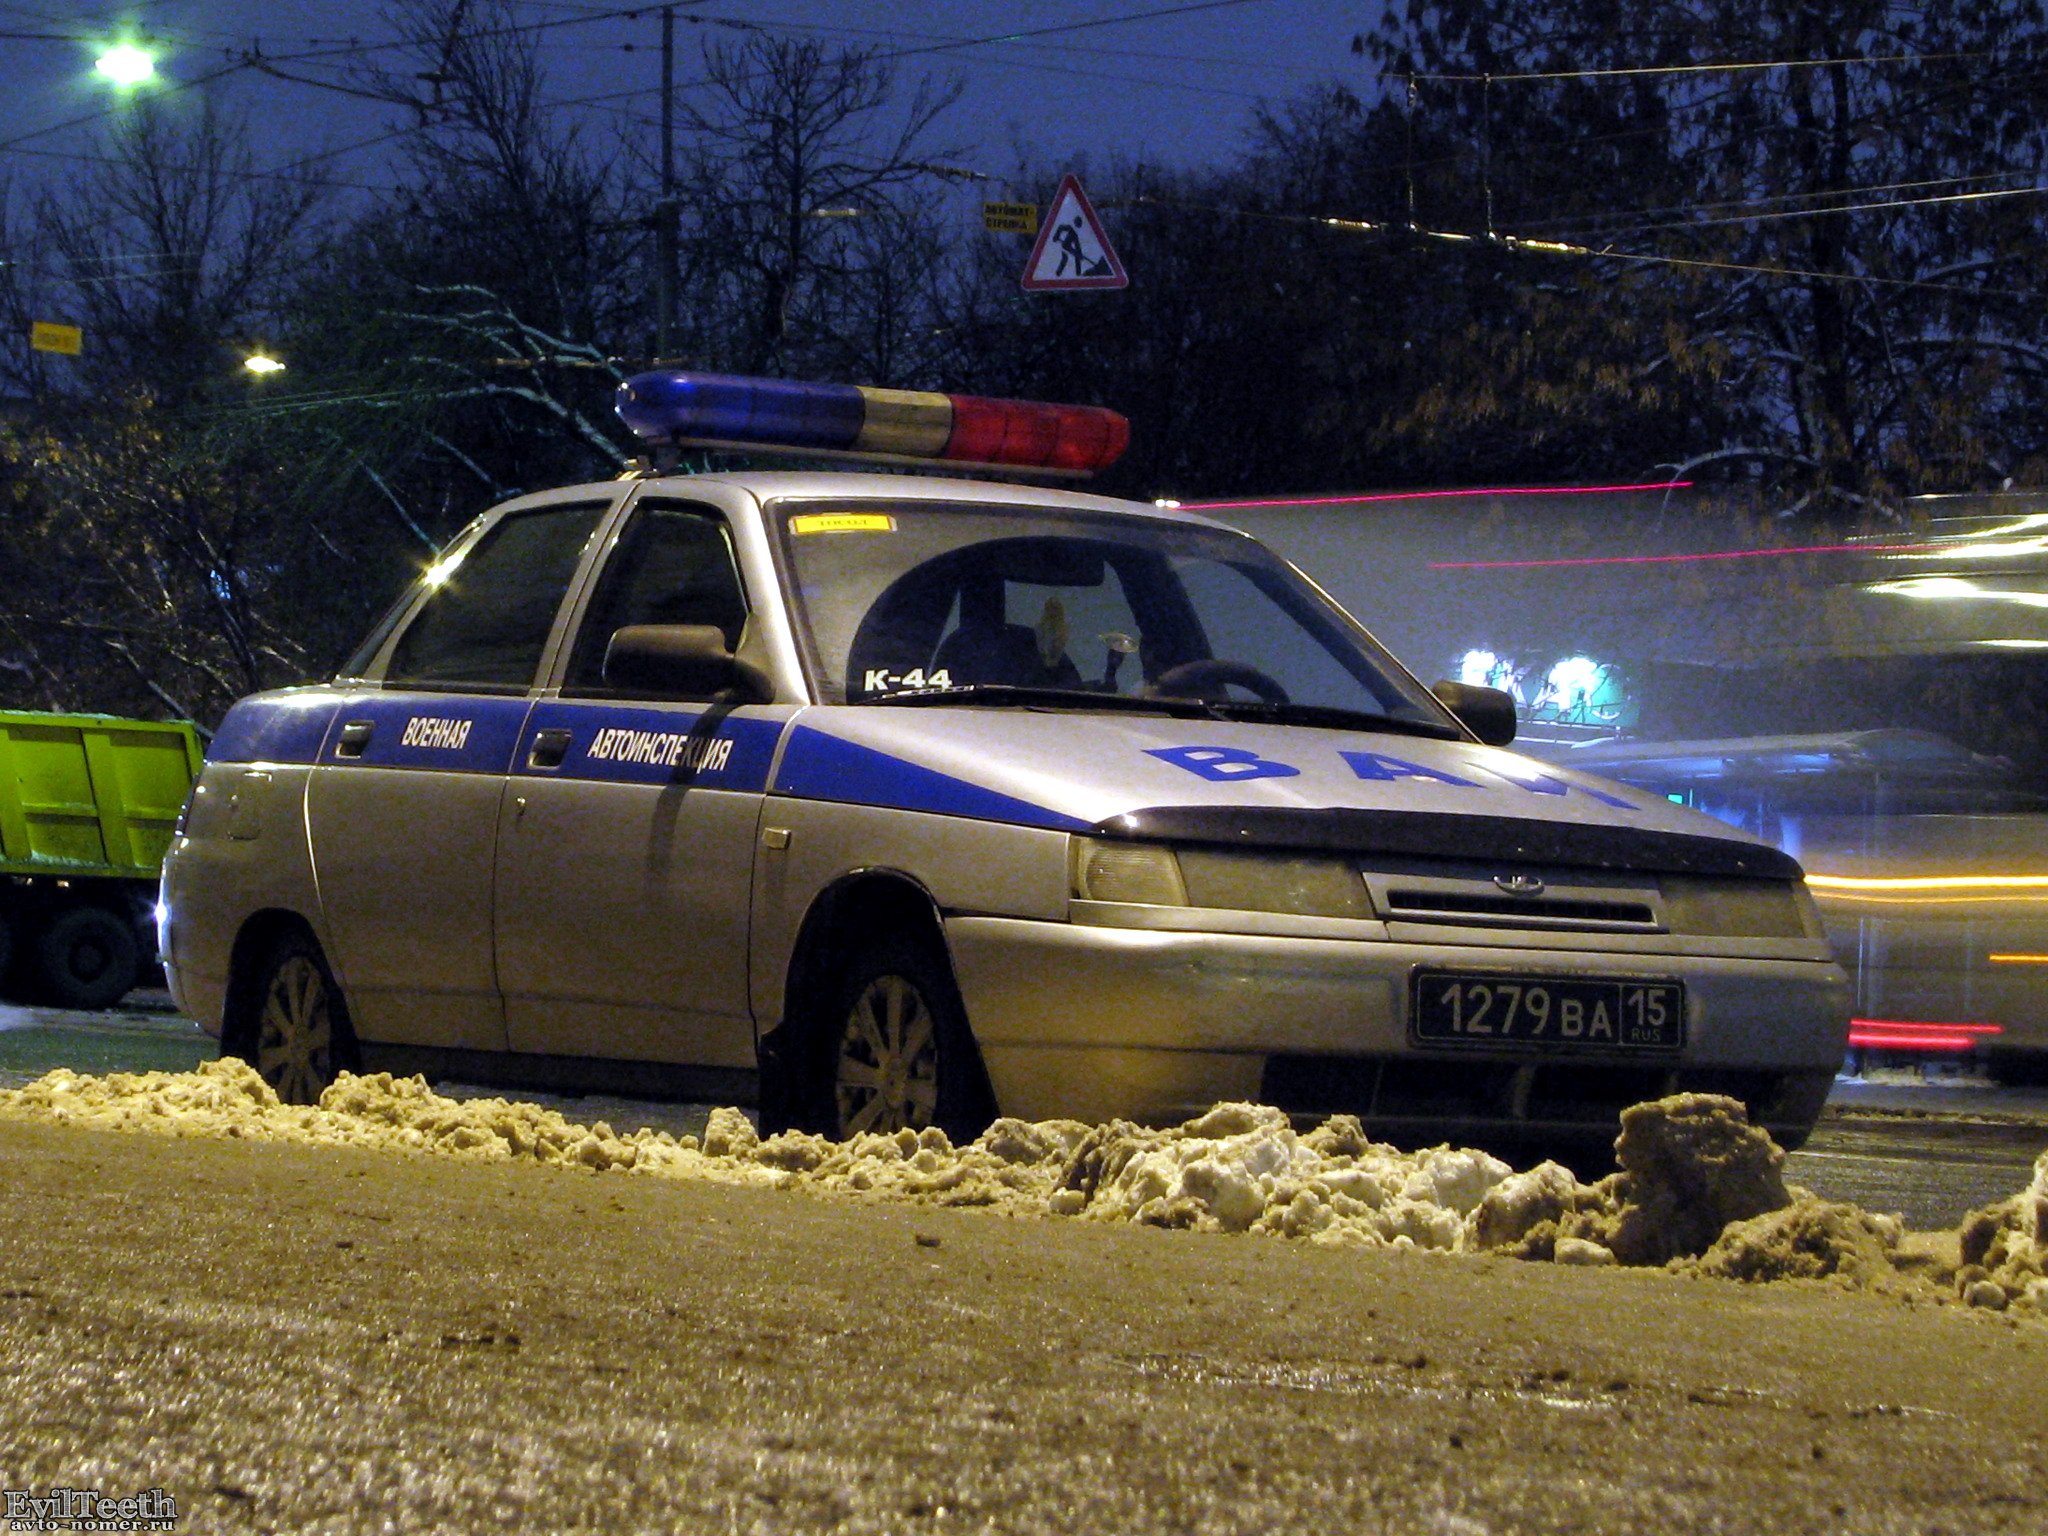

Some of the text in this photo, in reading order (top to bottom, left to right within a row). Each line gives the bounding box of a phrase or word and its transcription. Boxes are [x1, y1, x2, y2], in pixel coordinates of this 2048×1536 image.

[864, 668, 953, 691] К-44
[401, 717, 733, 774] ВОЕННАЯ АВТОИНСПЕКЦИЯ
[1441, 983, 1666, 1038] 1279 ВА 15
[1631, 1029, 1661, 1042] RUS
